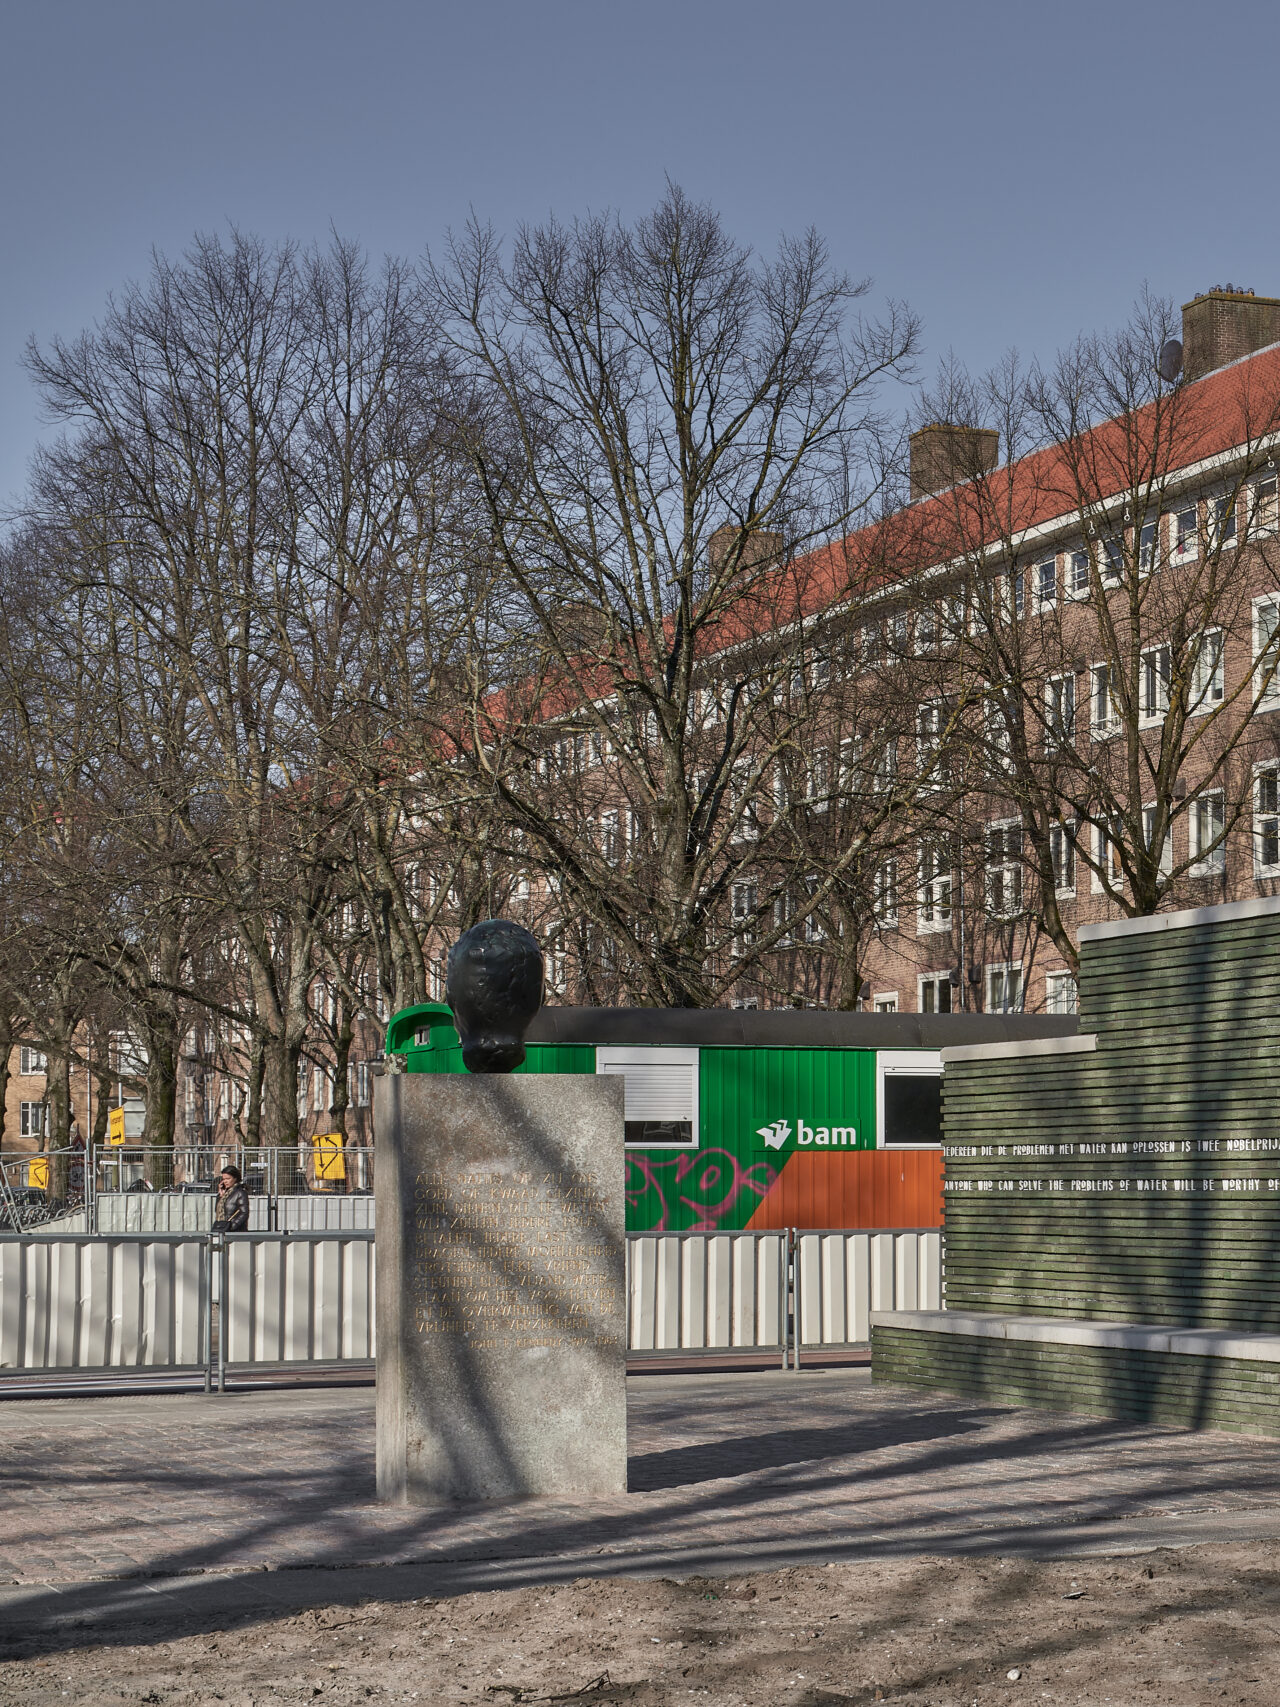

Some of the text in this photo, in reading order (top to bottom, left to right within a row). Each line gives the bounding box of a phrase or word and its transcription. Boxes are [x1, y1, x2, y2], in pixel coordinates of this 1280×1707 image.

[797, 1119, 856, 1145] bam
[943, 1146, 977, 1157] IEDEREEN
[981, 1145, 993, 1156] DIE
[998, 1145, 1007, 1156] DE
[1013, 1144, 1054, 1156] PROBLEMEN
[1059, 1143, 1074, 1155] MET
[1080, 1143, 1106, 1155] WATER
[1111, 1142, 1127, 1153] KAN
[1133, 1141, 1175, 1153] OPLOSSEN
[1181, 1140, 1191, 1152] IS
[1197, 1140, 1220, 1152] TWEE
[944, 1180, 973, 1191] ANYONE
[978, 1180, 993, 1191] WHO
[998, 1180, 1014, 1191] CAN
[1019, 1180, 1043, 1191] SOLVE
[1049, 1180, 1064, 1191] THE
[1071, 1180, 1113, 1191] PROBLEMS
[1120, 1180, 1130, 1191] OF
[1137, 1180, 1168, 1191] WATER
[1174, 1180, 1196, 1191] WILL
[1203, 1180, 1215, 1191] BE
[1222, 1179, 1260, 1191] WORTHY
[1268, 1179, 1280, 1191] OF
